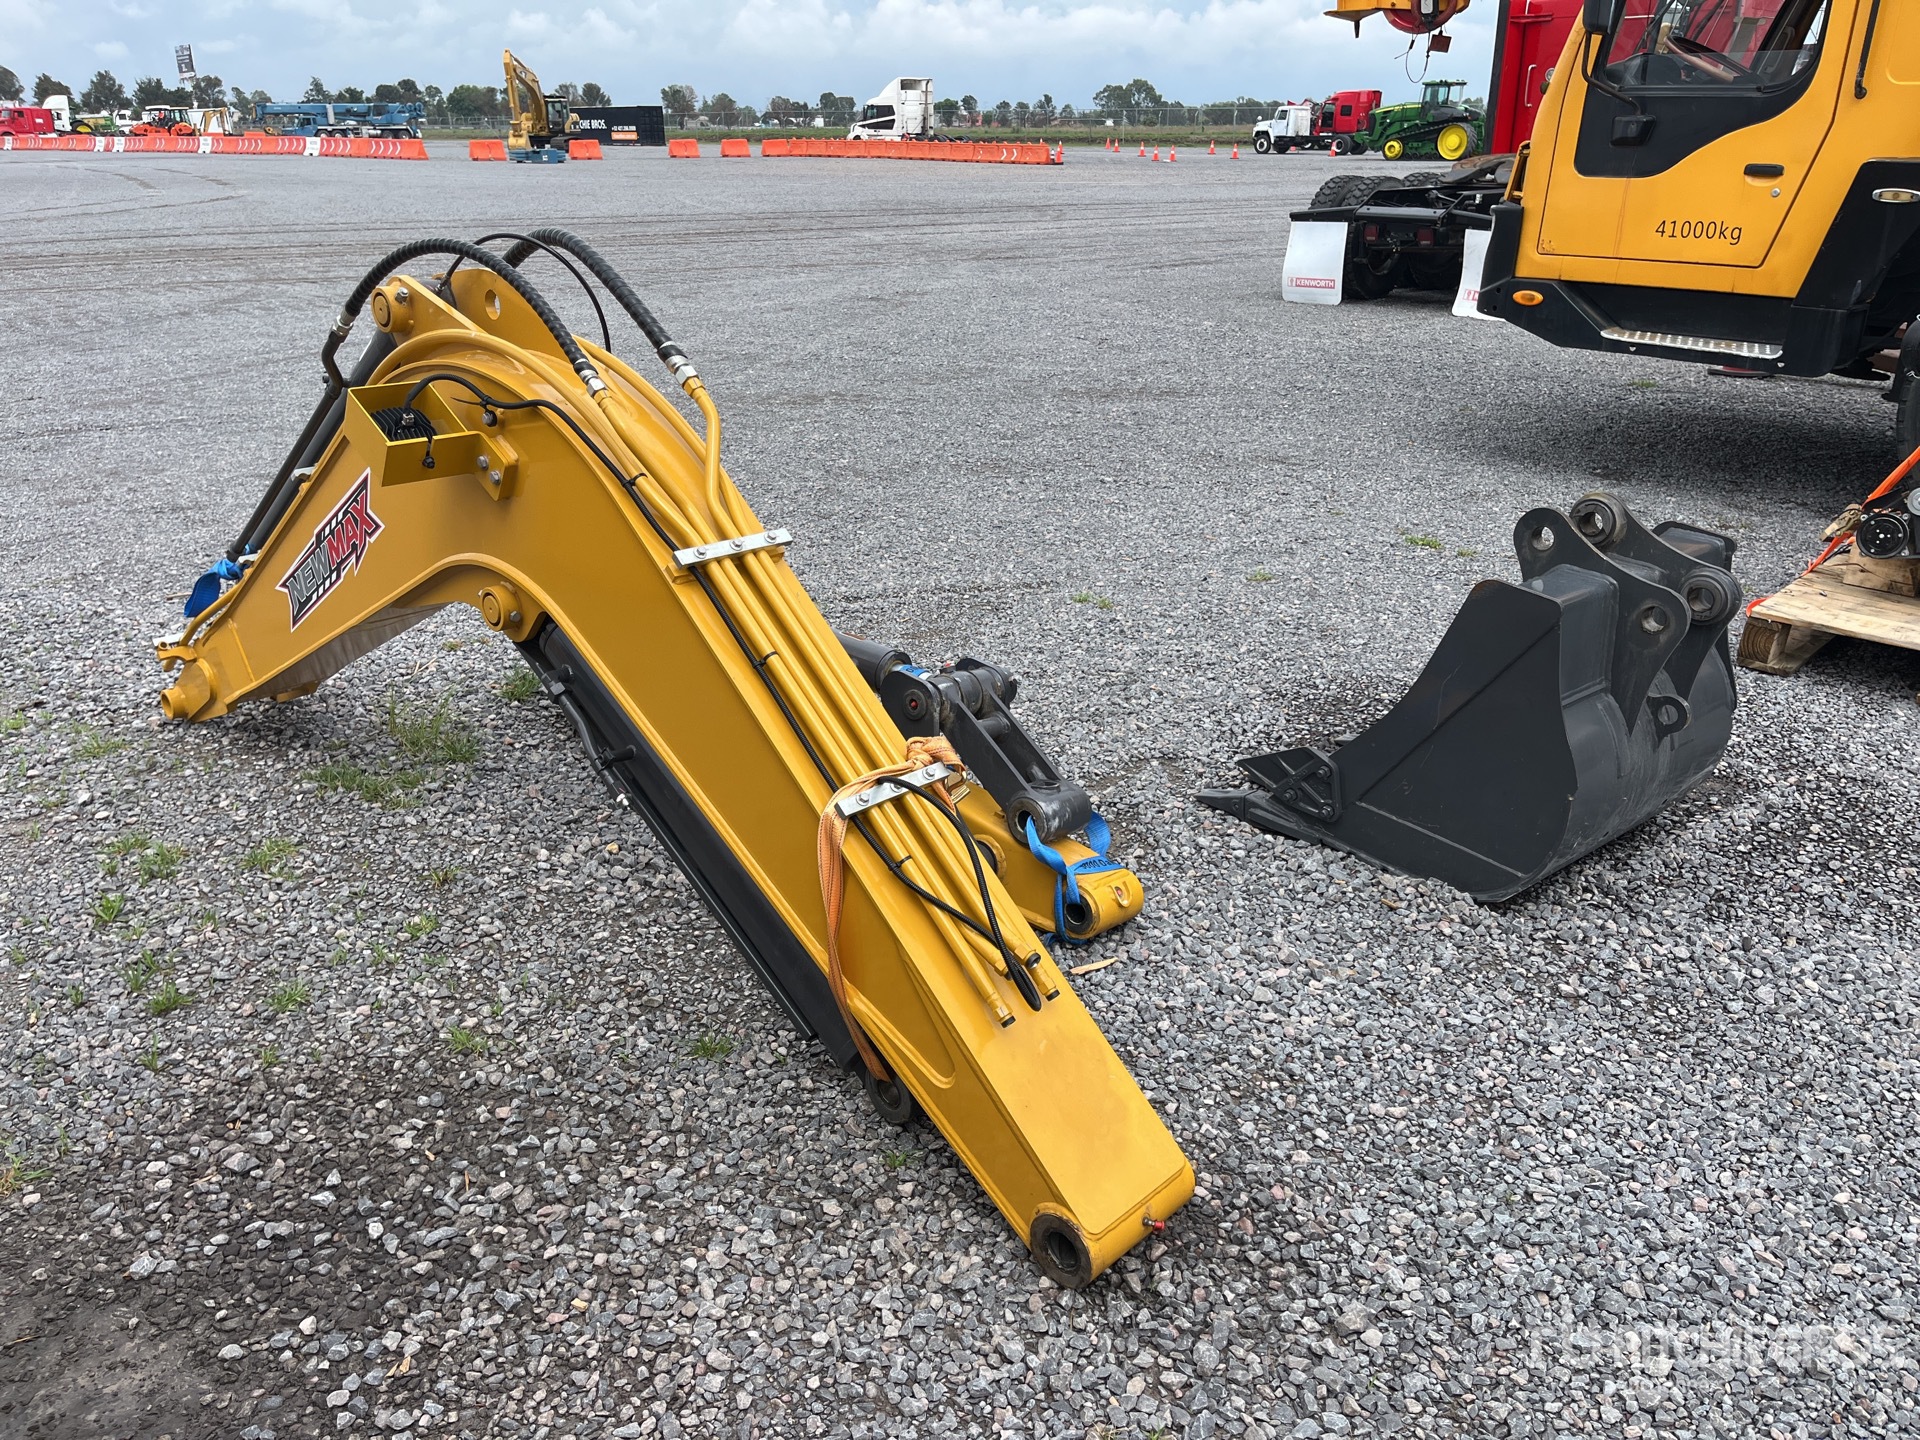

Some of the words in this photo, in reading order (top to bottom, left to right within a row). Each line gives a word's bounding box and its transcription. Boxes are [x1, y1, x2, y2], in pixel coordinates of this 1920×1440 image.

[1655, 219, 1743, 246] 41000kg
[1296, 279, 1335, 289] KENWORTH
[286, 490, 377, 612] NEWMAX
